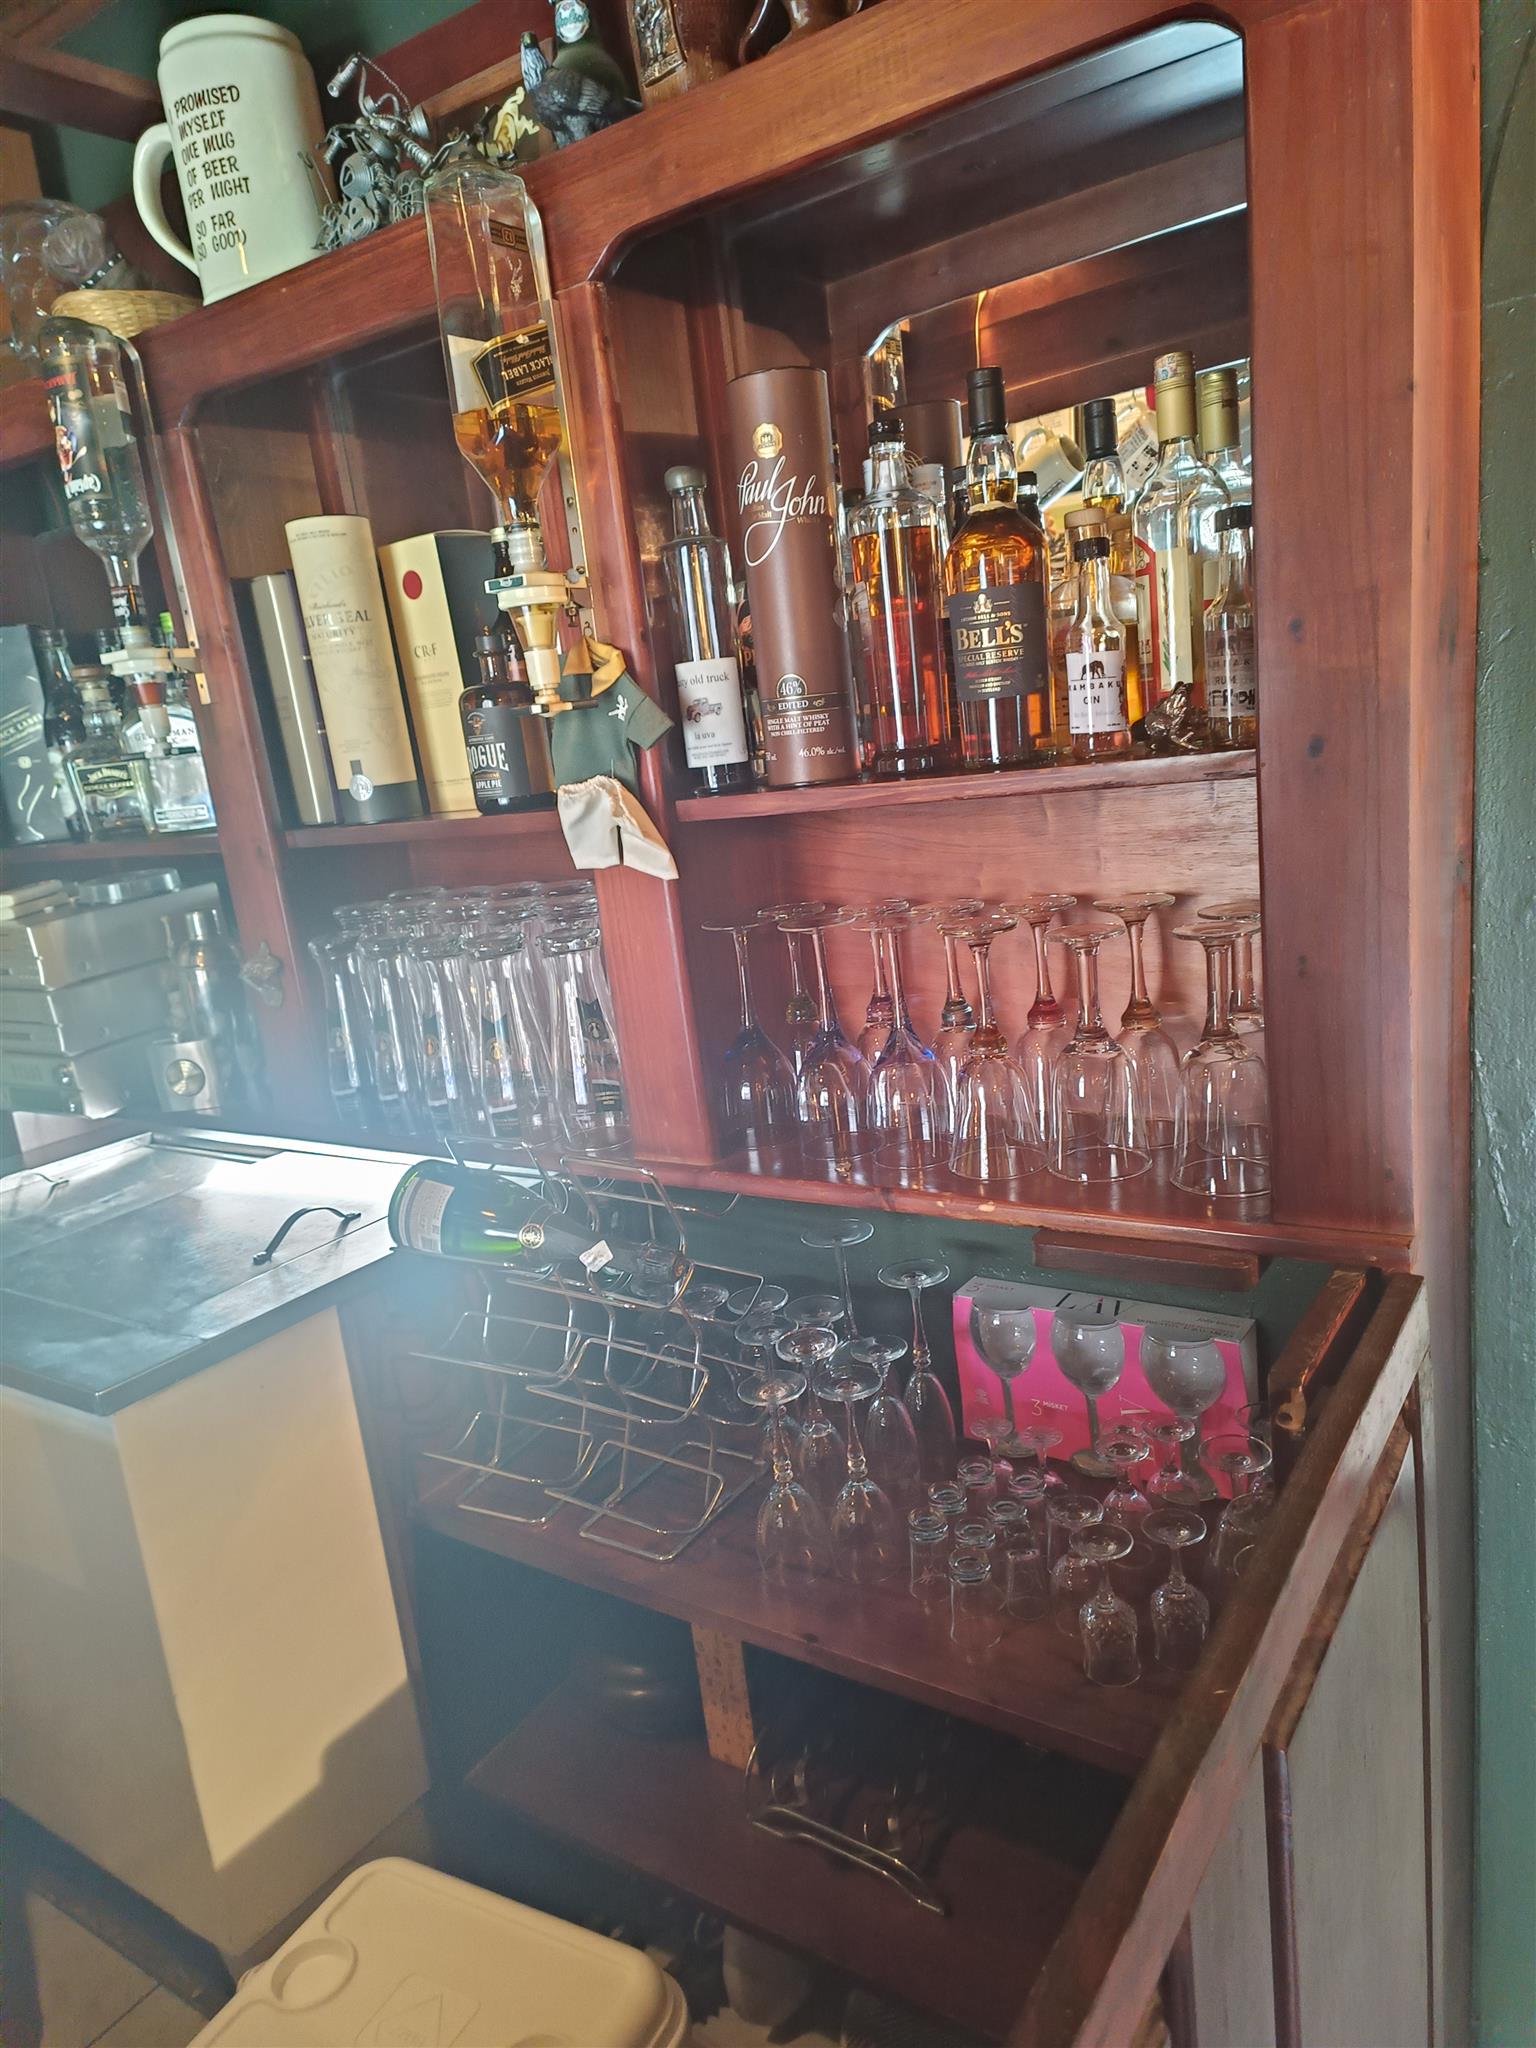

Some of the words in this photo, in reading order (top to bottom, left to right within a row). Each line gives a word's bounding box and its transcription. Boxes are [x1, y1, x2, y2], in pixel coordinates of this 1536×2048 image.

[174, 84, 240, 119] PROMISED
[178, 109, 226, 141] MYSELF
[181, 141, 200, 166] ONE
[203, 131, 235, 155] MUG
[187, 167, 198, 188] OF
[202, 155, 240, 180] BEER
[188, 189, 205, 212] PER
[210, 176, 250, 201] NIGHT
[195, 220, 207, 241] SO
[210, 210, 236, 233] FAR
[197, 242, 207, 262] SO
[211, 230, 247, 253] GOOD
[502, 363, 530, 381] LABEL
[737, 455, 786, 515] Paul
[744, 475, 827, 567] John
[956, 620, 1024, 651] BELL'S
[985, 648, 1024, 658] RESERVE
[690, 674, 705, 686] old
[706, 671, 730, 683] truck
[780, 680, 802, 696] 46%
[778, 700, 809, 711] EDITED
[1083, 695, 1101, 705] GIN
[784, 715, 802, 723] MALT
[802, 713, 830, 721] WHISKY
[785, 719, 801, 729] HINT
[803, 719, 813, 728] OF
[813, 717, 832, 727] PEAT
[799, 746, 826, 758] 46.0%
[1032, 1398, 1042, 1416] 3
